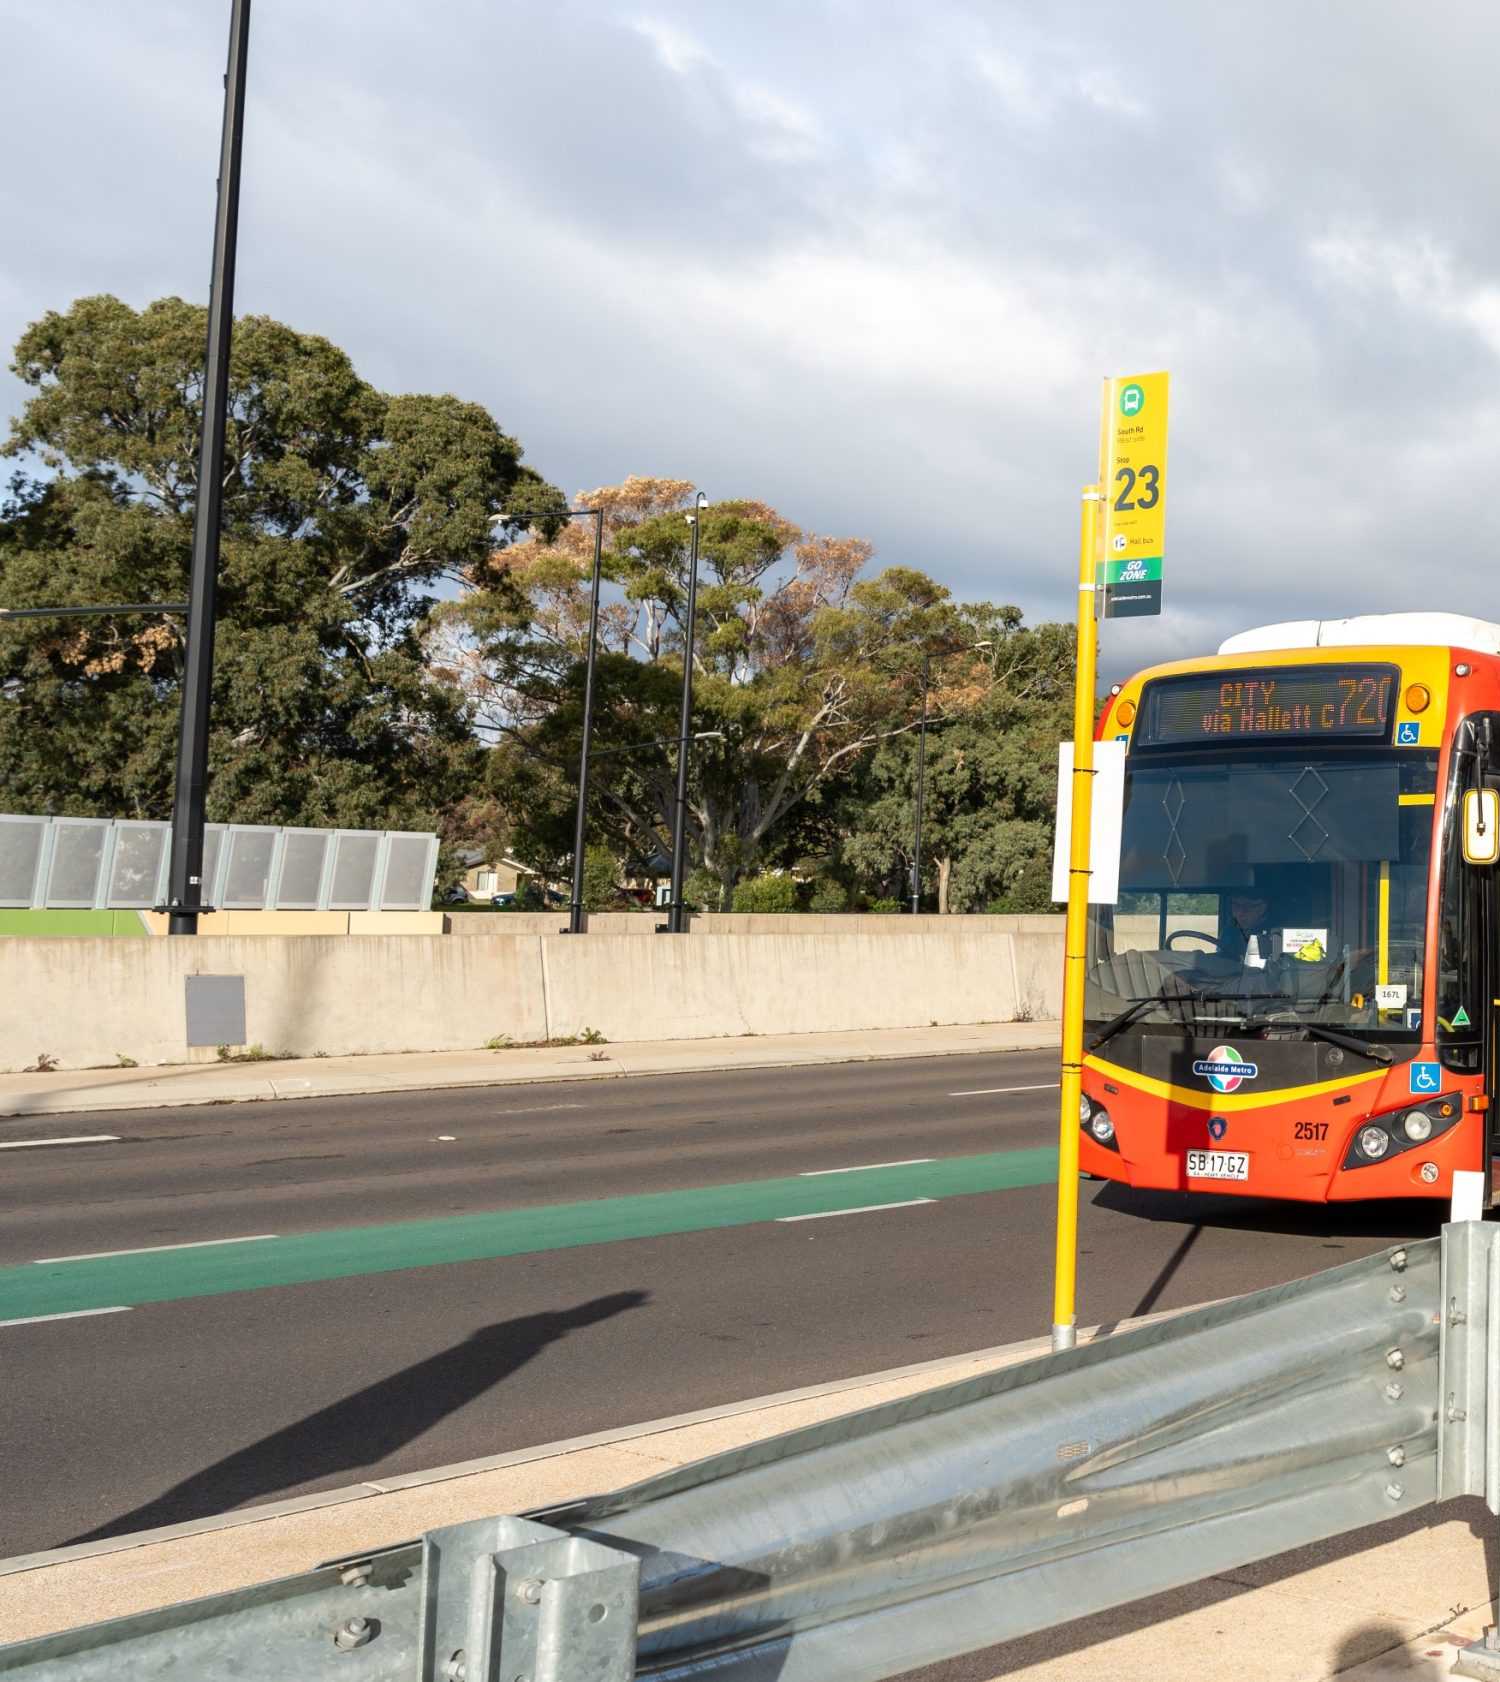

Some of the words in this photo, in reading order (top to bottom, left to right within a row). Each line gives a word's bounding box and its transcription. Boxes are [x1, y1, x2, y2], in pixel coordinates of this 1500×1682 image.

[1114, 465, 1159, 511] 23
[1119, 570, 1148, 580] ZONE
[1127, 561, 1142, 570] GO
[1220, 681, 1276, 707] CITY
[1202, 710, 1231, 733] via
[1240, 705, 1311, 732] Hallett
[1199, 1064, 1229, 1073] Adelaide
[1230, 1066, 1252, 1074] Metro
[1294, 1121, 1329, 1141] 2517
